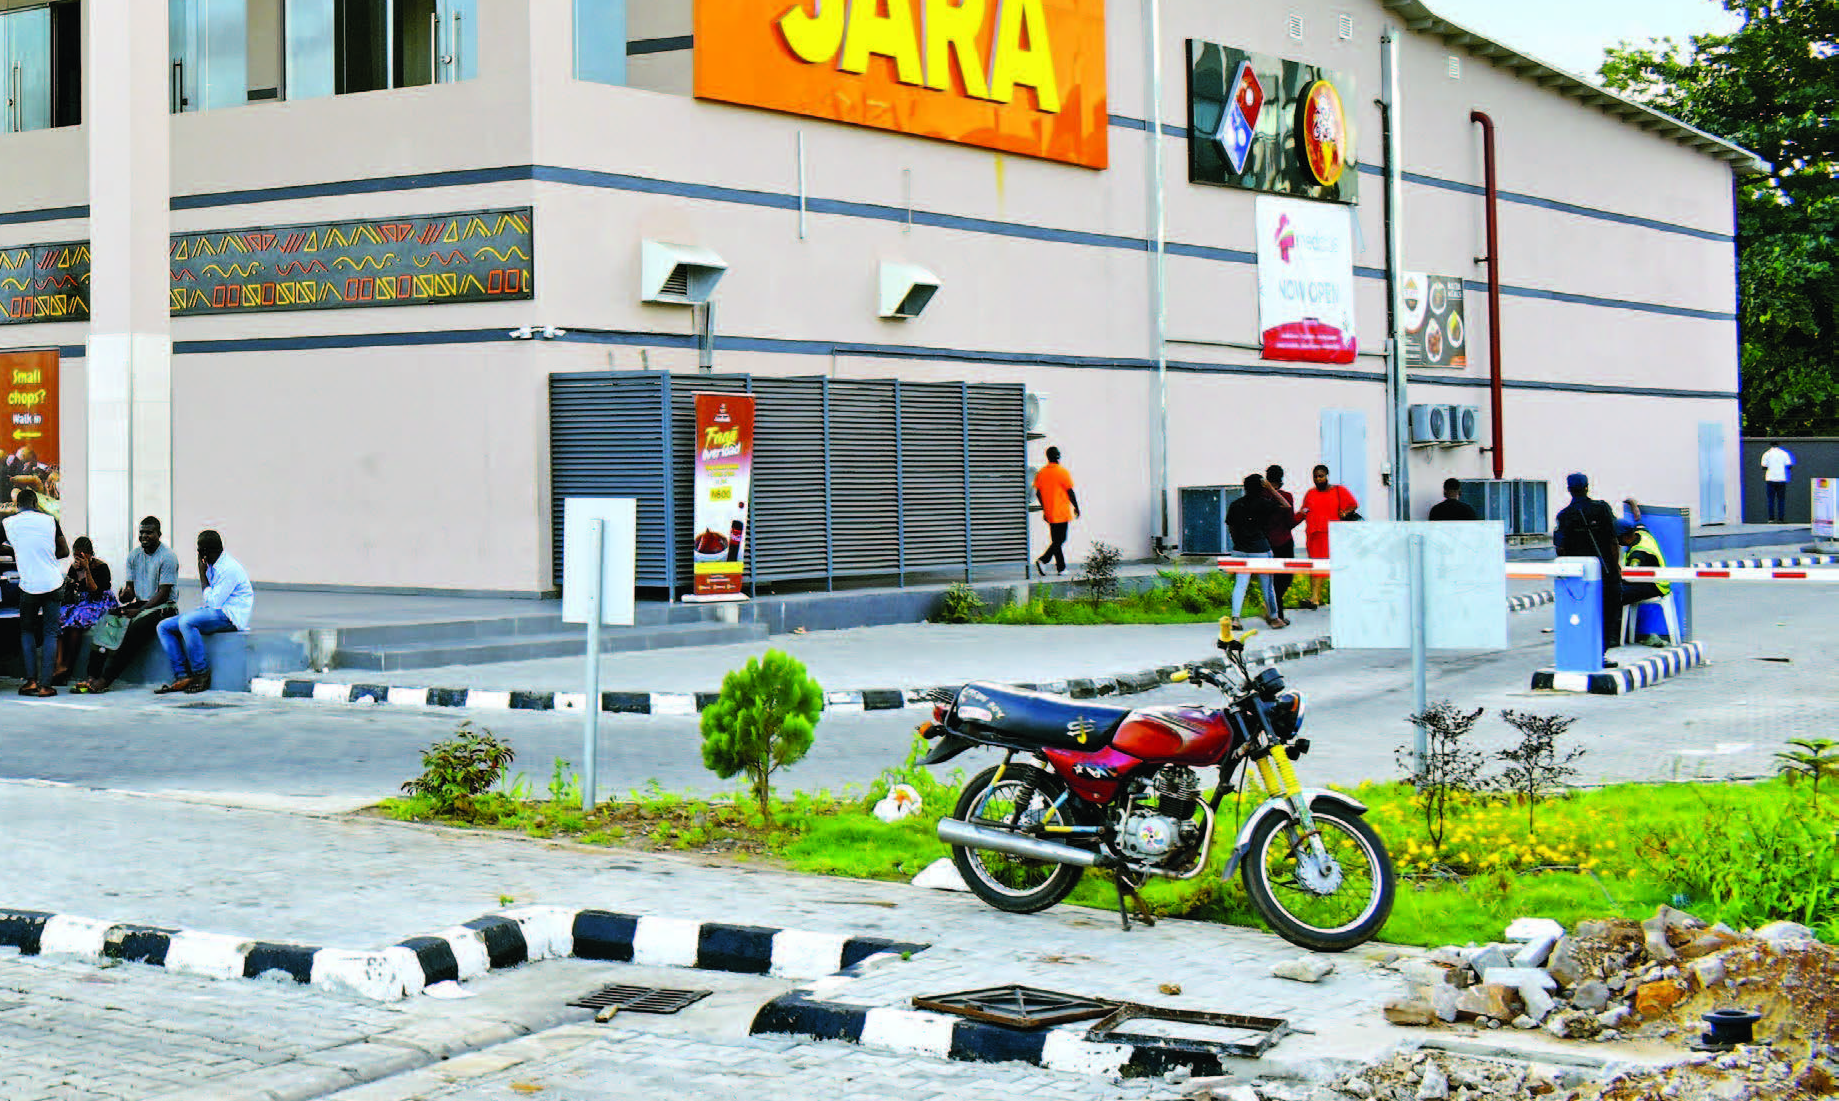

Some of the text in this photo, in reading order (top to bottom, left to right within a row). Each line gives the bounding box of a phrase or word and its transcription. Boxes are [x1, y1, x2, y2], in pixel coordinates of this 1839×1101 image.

[1280, 279, 1340, 304] NOW OPEN
[12, 367, 42, 385] Small
[8, 388, 47, 409] chops?
[12, 412, 43, 425] Walk in
